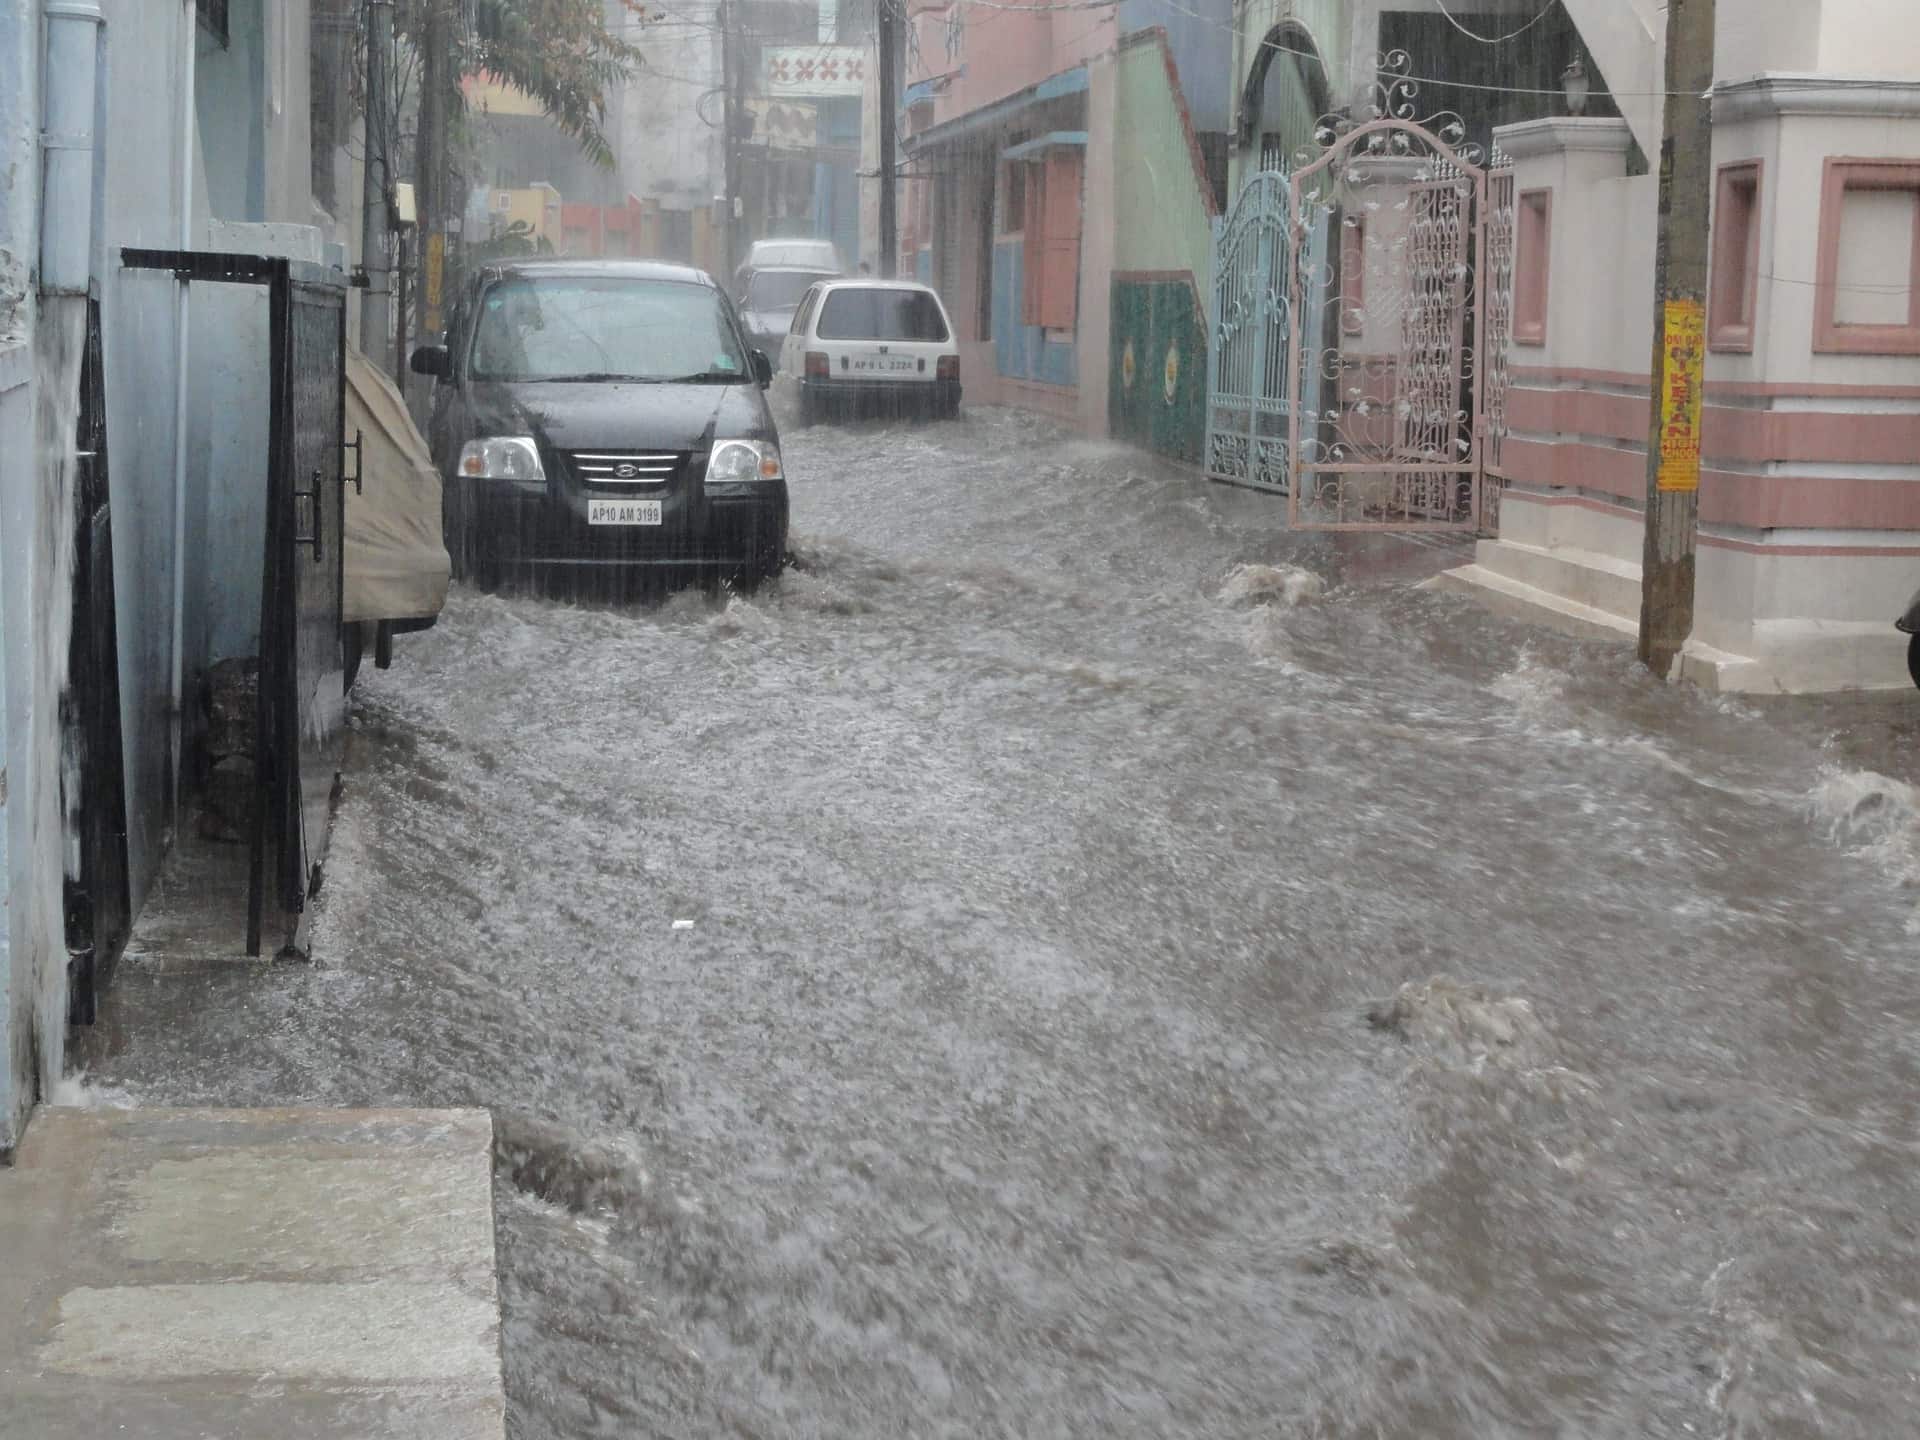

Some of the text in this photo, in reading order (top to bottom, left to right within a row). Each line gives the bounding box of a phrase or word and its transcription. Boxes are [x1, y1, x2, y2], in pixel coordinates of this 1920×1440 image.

[855, 361, 866, 369] AP
[592, 507, 659, 521] AP10 AM 3199
